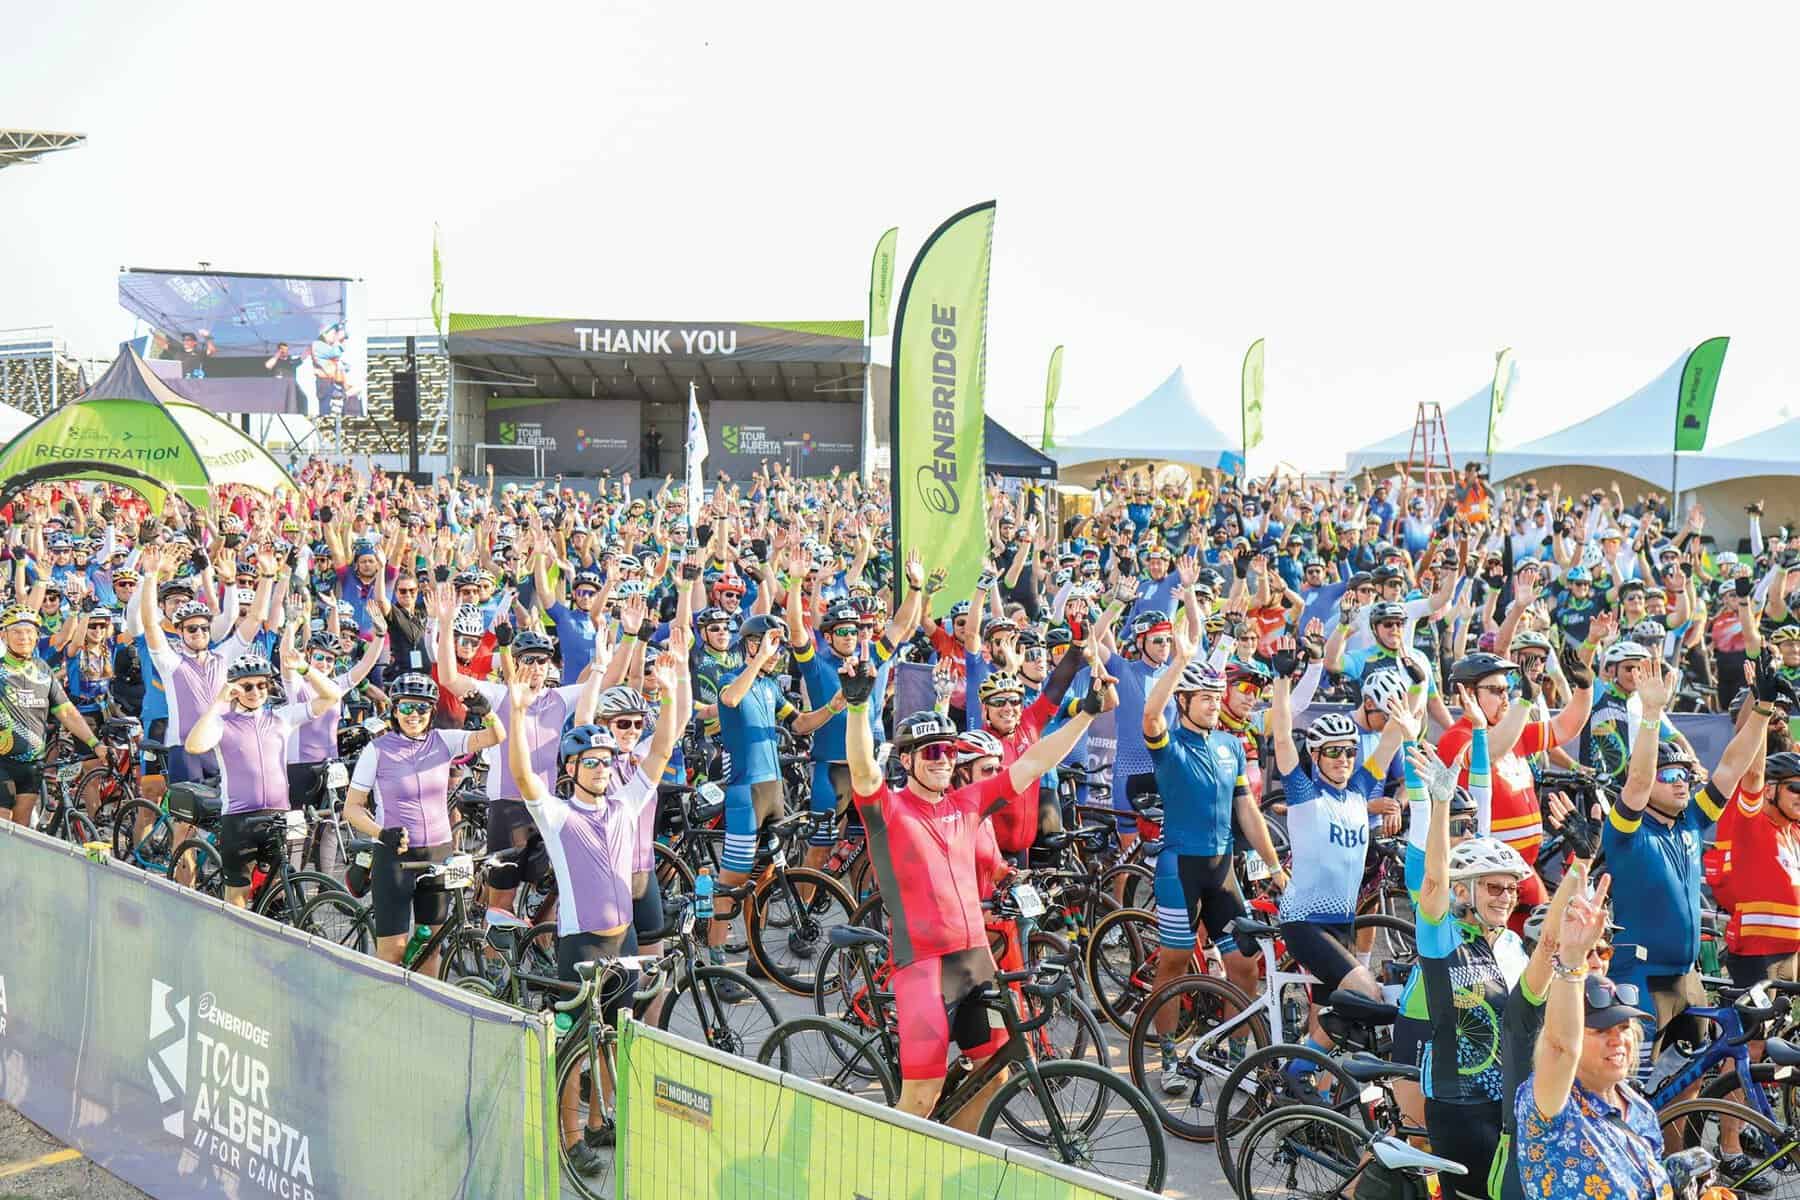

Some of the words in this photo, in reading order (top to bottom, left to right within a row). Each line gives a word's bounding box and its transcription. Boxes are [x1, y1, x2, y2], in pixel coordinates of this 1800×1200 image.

[574, 327, 673, 354] THANK
[680, 329, 737, 355] YOU
[930, 303, 959, 483] ENBRIDGE
[739, 431, 766, 441] TOUR
[739, 440, 781, 450] ALBERTA
[35, 443, 180, 461] REGISTRATION
[915, 722, 936, 736] 0774
[1329, 822, 1367, 849] RBC
[1250, 860, 1265, 873] 077
[208, 1007, 271, 1049] ENBRIDGE
[197, 1032, 270, 1110] TOUR
[192, 1082, 314, 1187] ALBERTA
[209, 1134, 241, 1170] FOR
